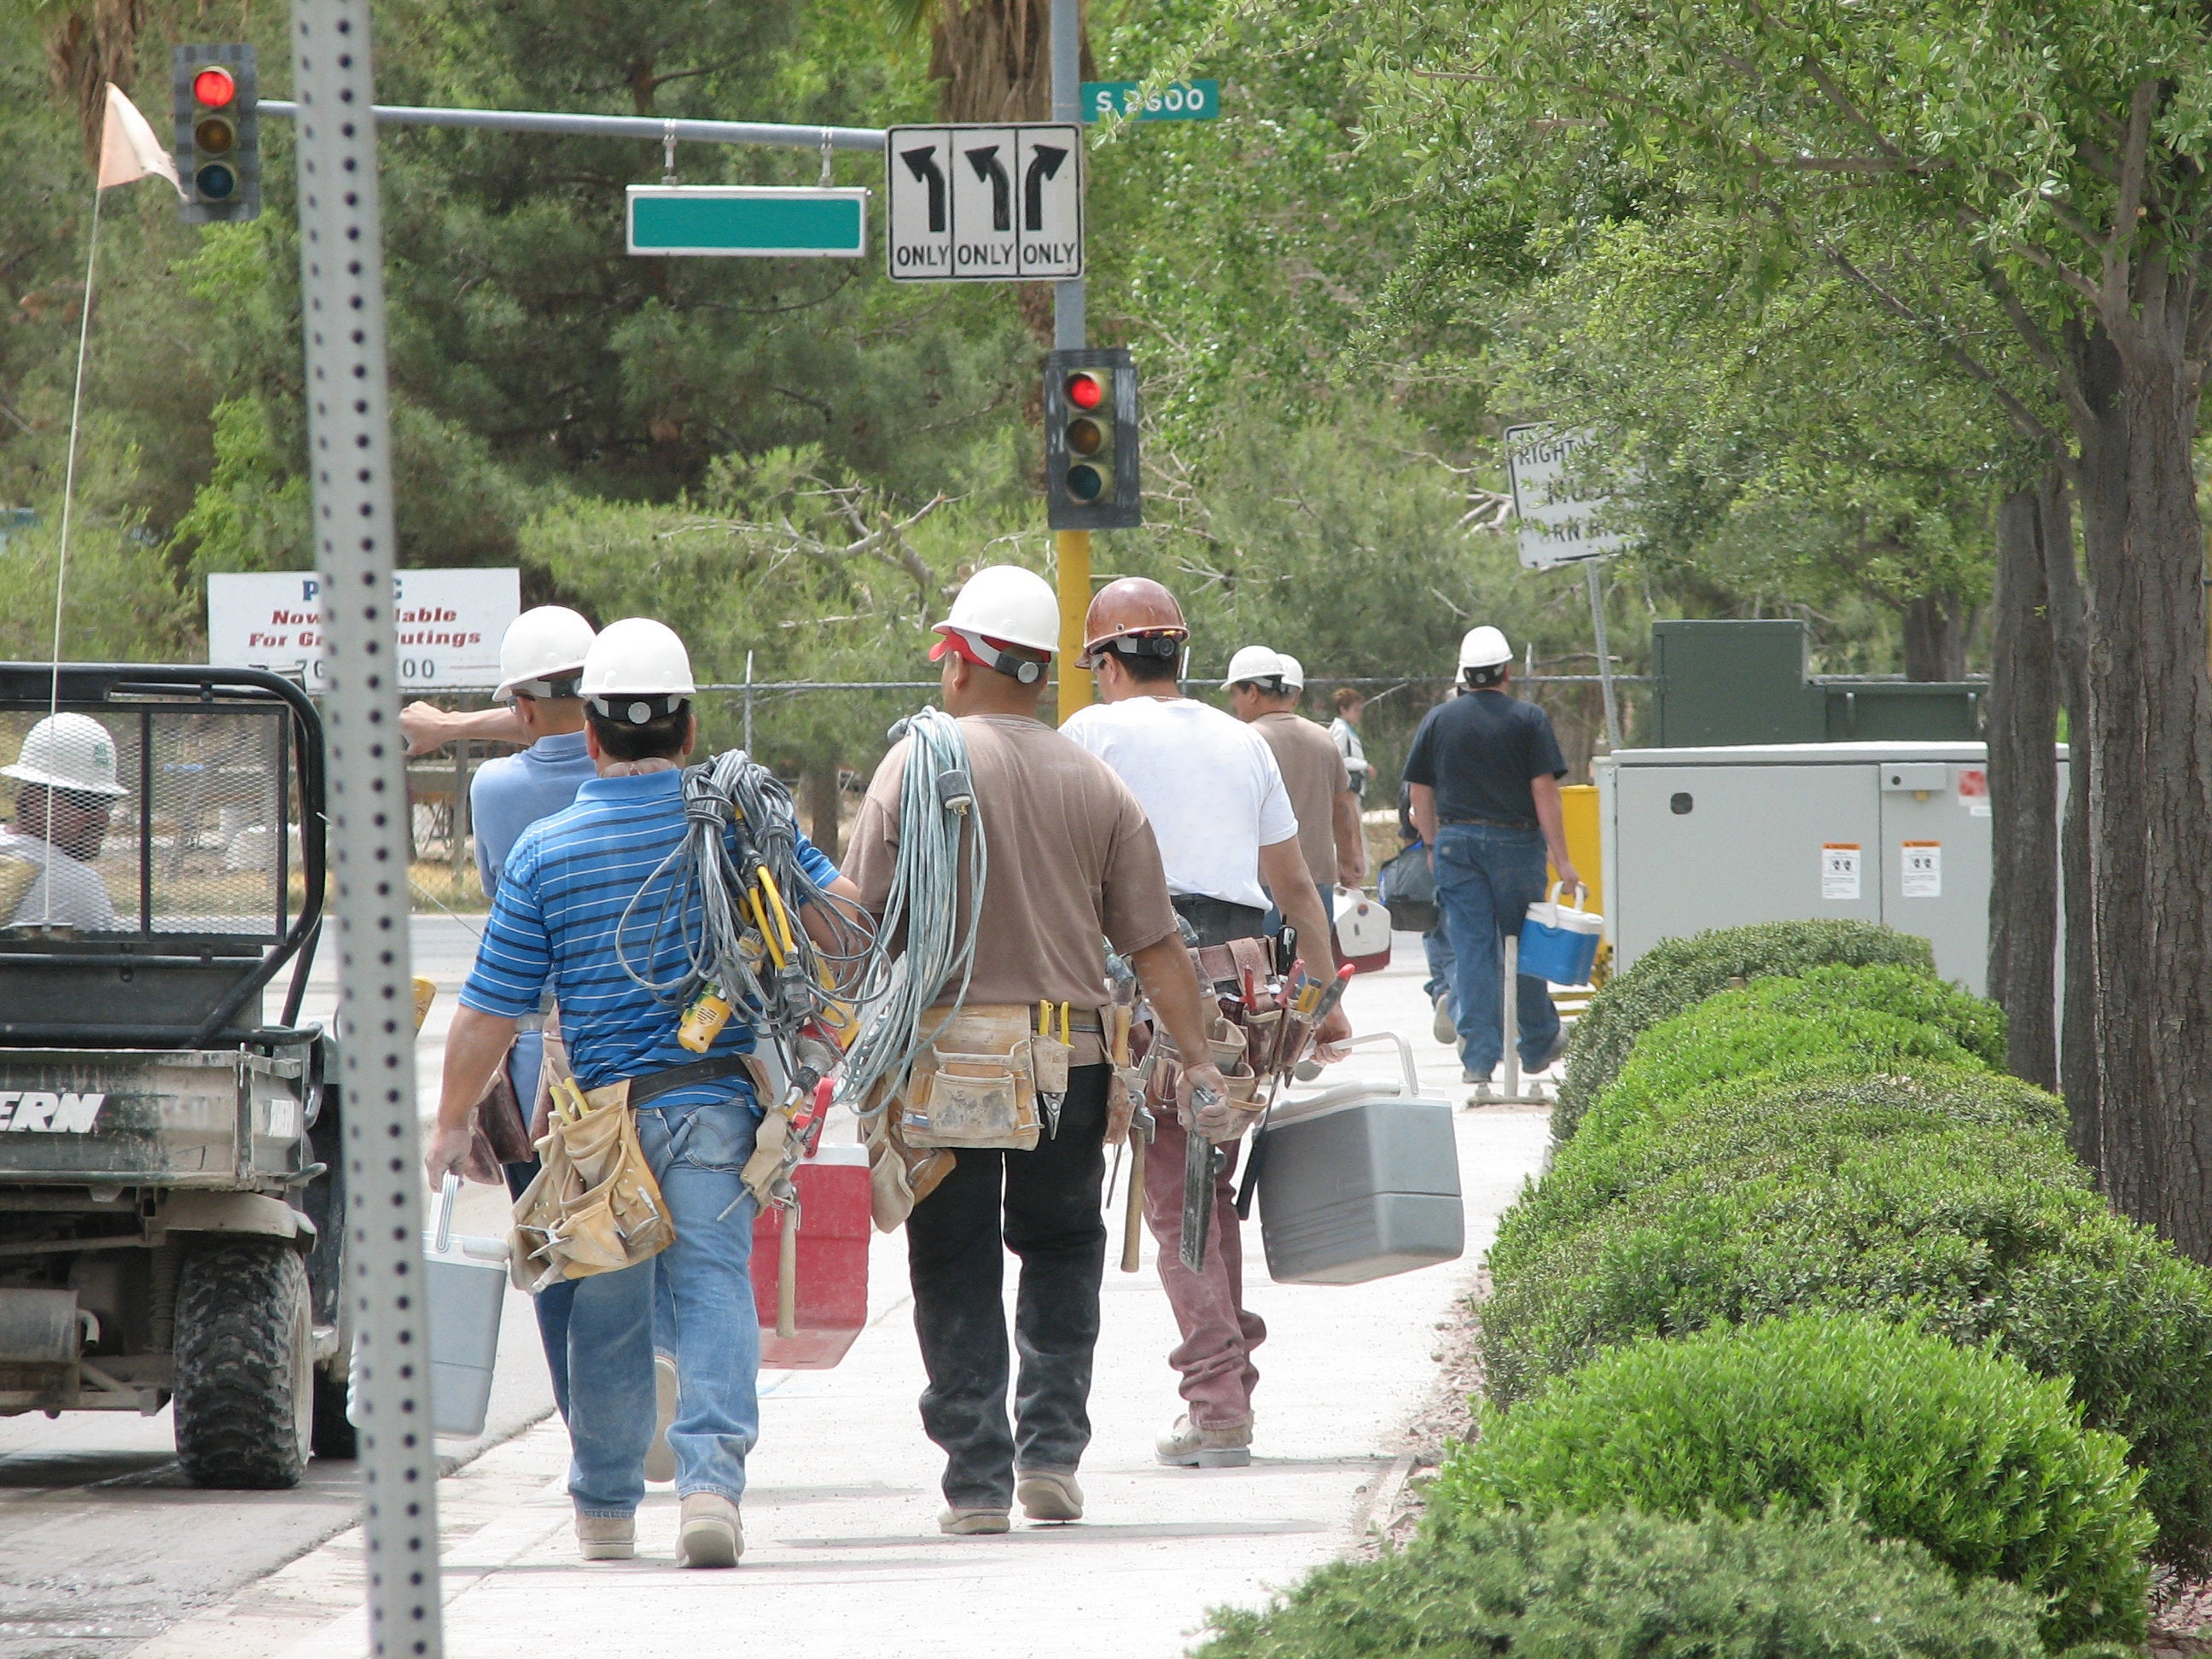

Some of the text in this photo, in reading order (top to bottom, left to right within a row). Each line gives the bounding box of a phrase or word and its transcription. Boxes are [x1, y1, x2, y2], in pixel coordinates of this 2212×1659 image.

[1096, 90, 1113, 112] S
[897, 245, 950, 266] ONLY
[958, 244, 1014, 265] ONLY
[1024, 242, 1075, 265] ONLY
[248, 632, 288, 648] For
[393, 630, 481, 648] utings
